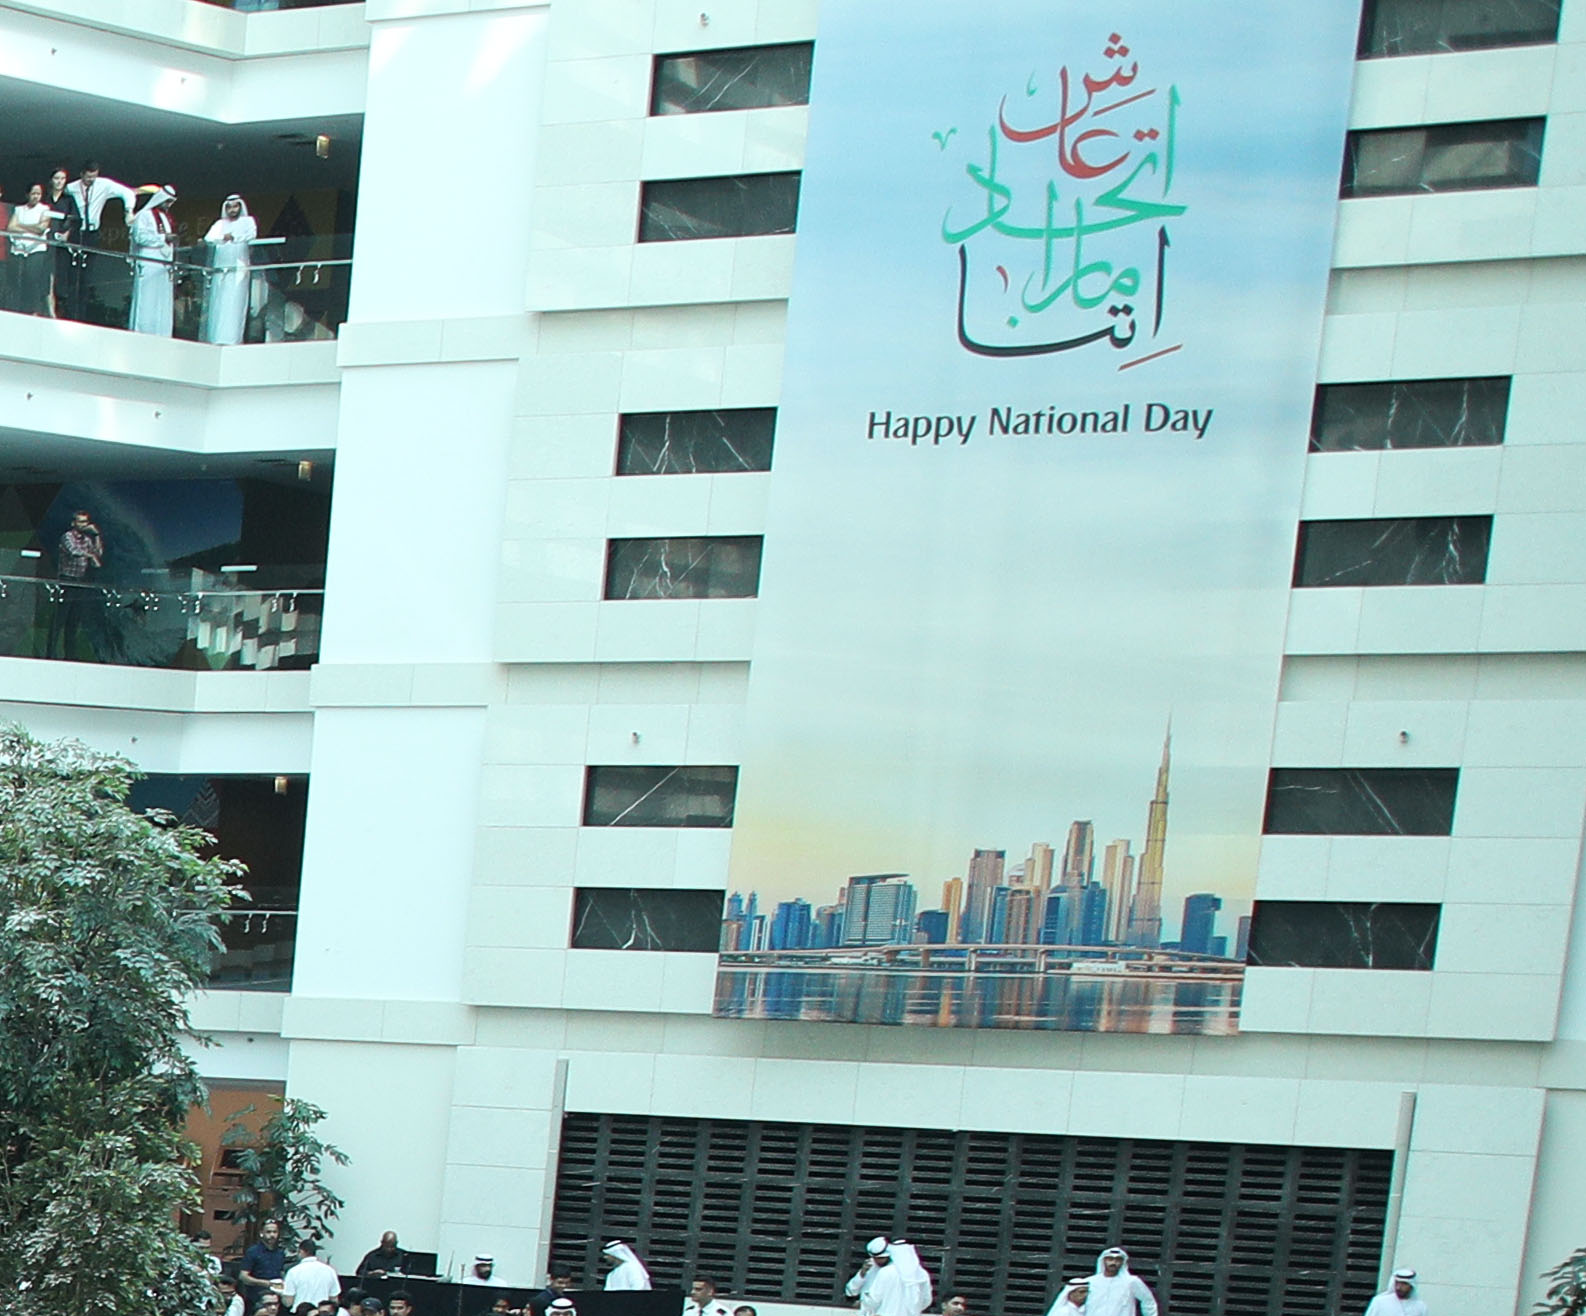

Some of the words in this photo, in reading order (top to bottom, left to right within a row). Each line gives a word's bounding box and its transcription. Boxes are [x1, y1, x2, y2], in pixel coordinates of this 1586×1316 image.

[867, 409, 977, 446] Happy
[989, 404, 1130, 437] National
[1145, 402, 1214, 439] Day
